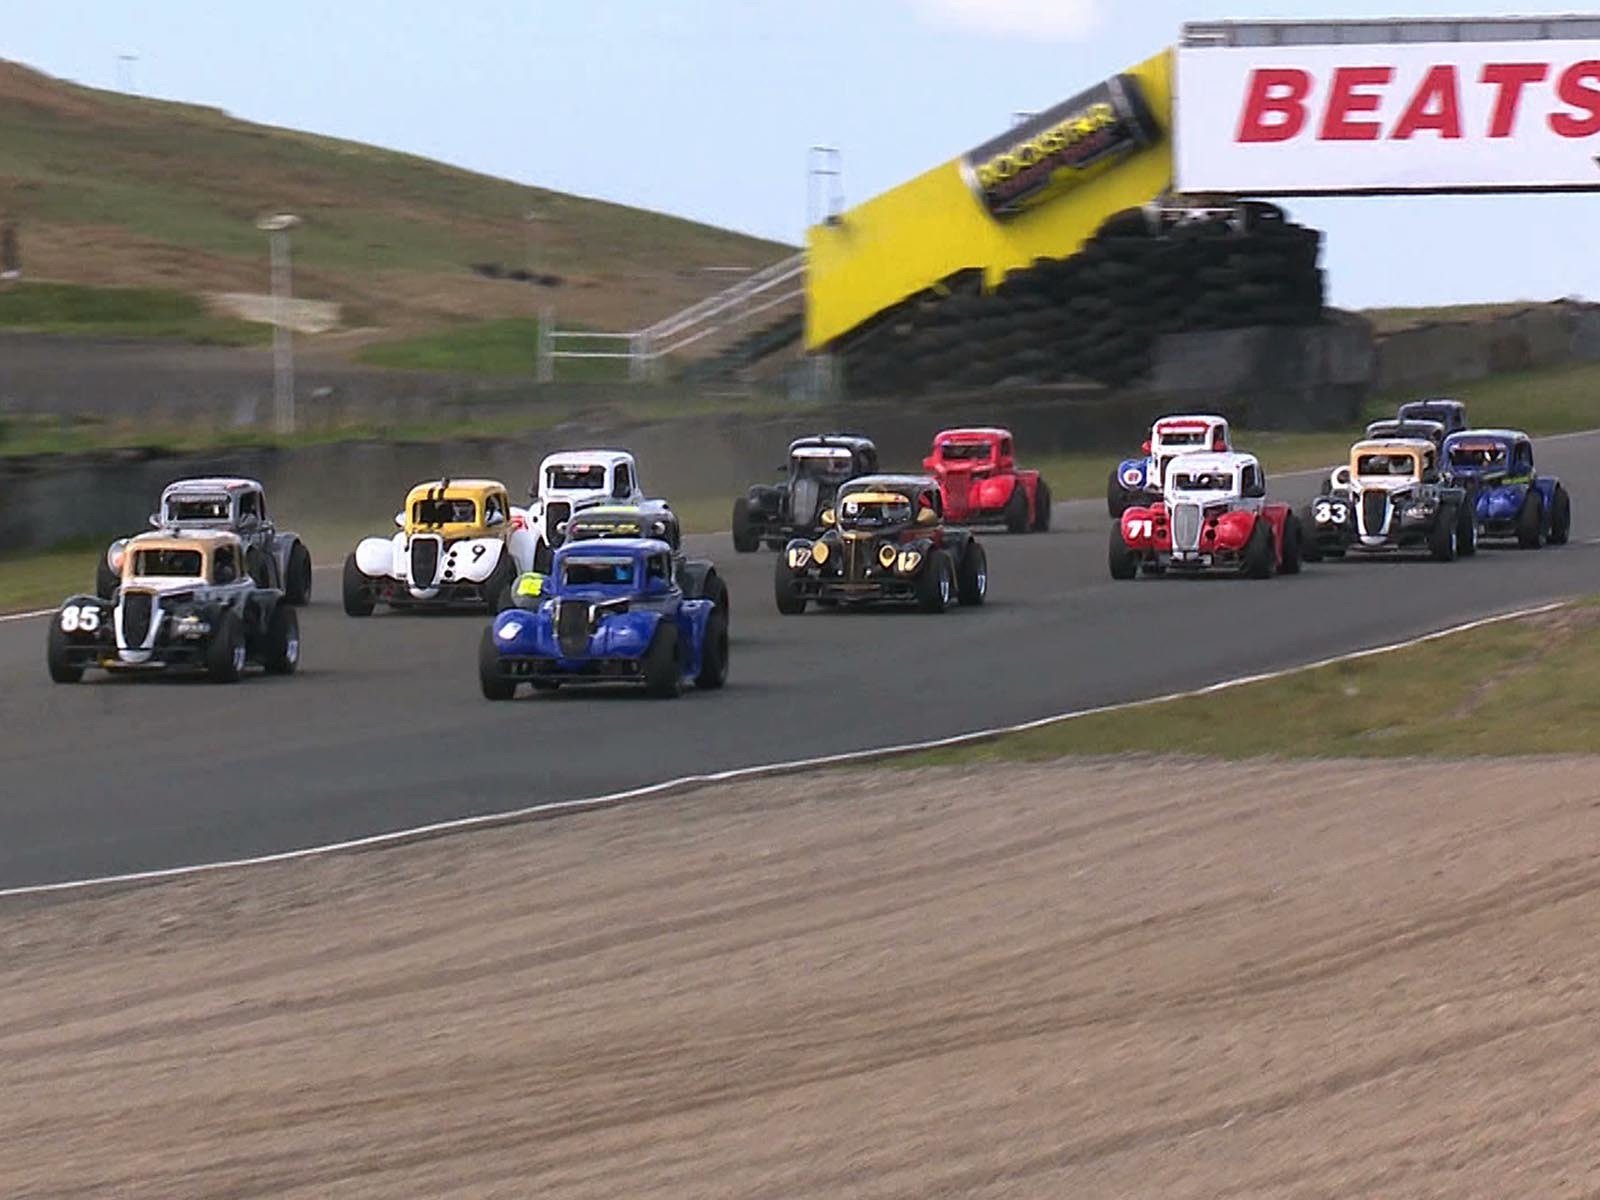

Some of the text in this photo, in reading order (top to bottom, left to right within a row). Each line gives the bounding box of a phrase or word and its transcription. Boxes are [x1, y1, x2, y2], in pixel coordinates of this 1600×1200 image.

[1234, 60, 1600, 143] BEATS
[1127, 519, 1153, 539] 71
[471, 544, 487, 564] 9
[60, 604, 101, 633] 85
